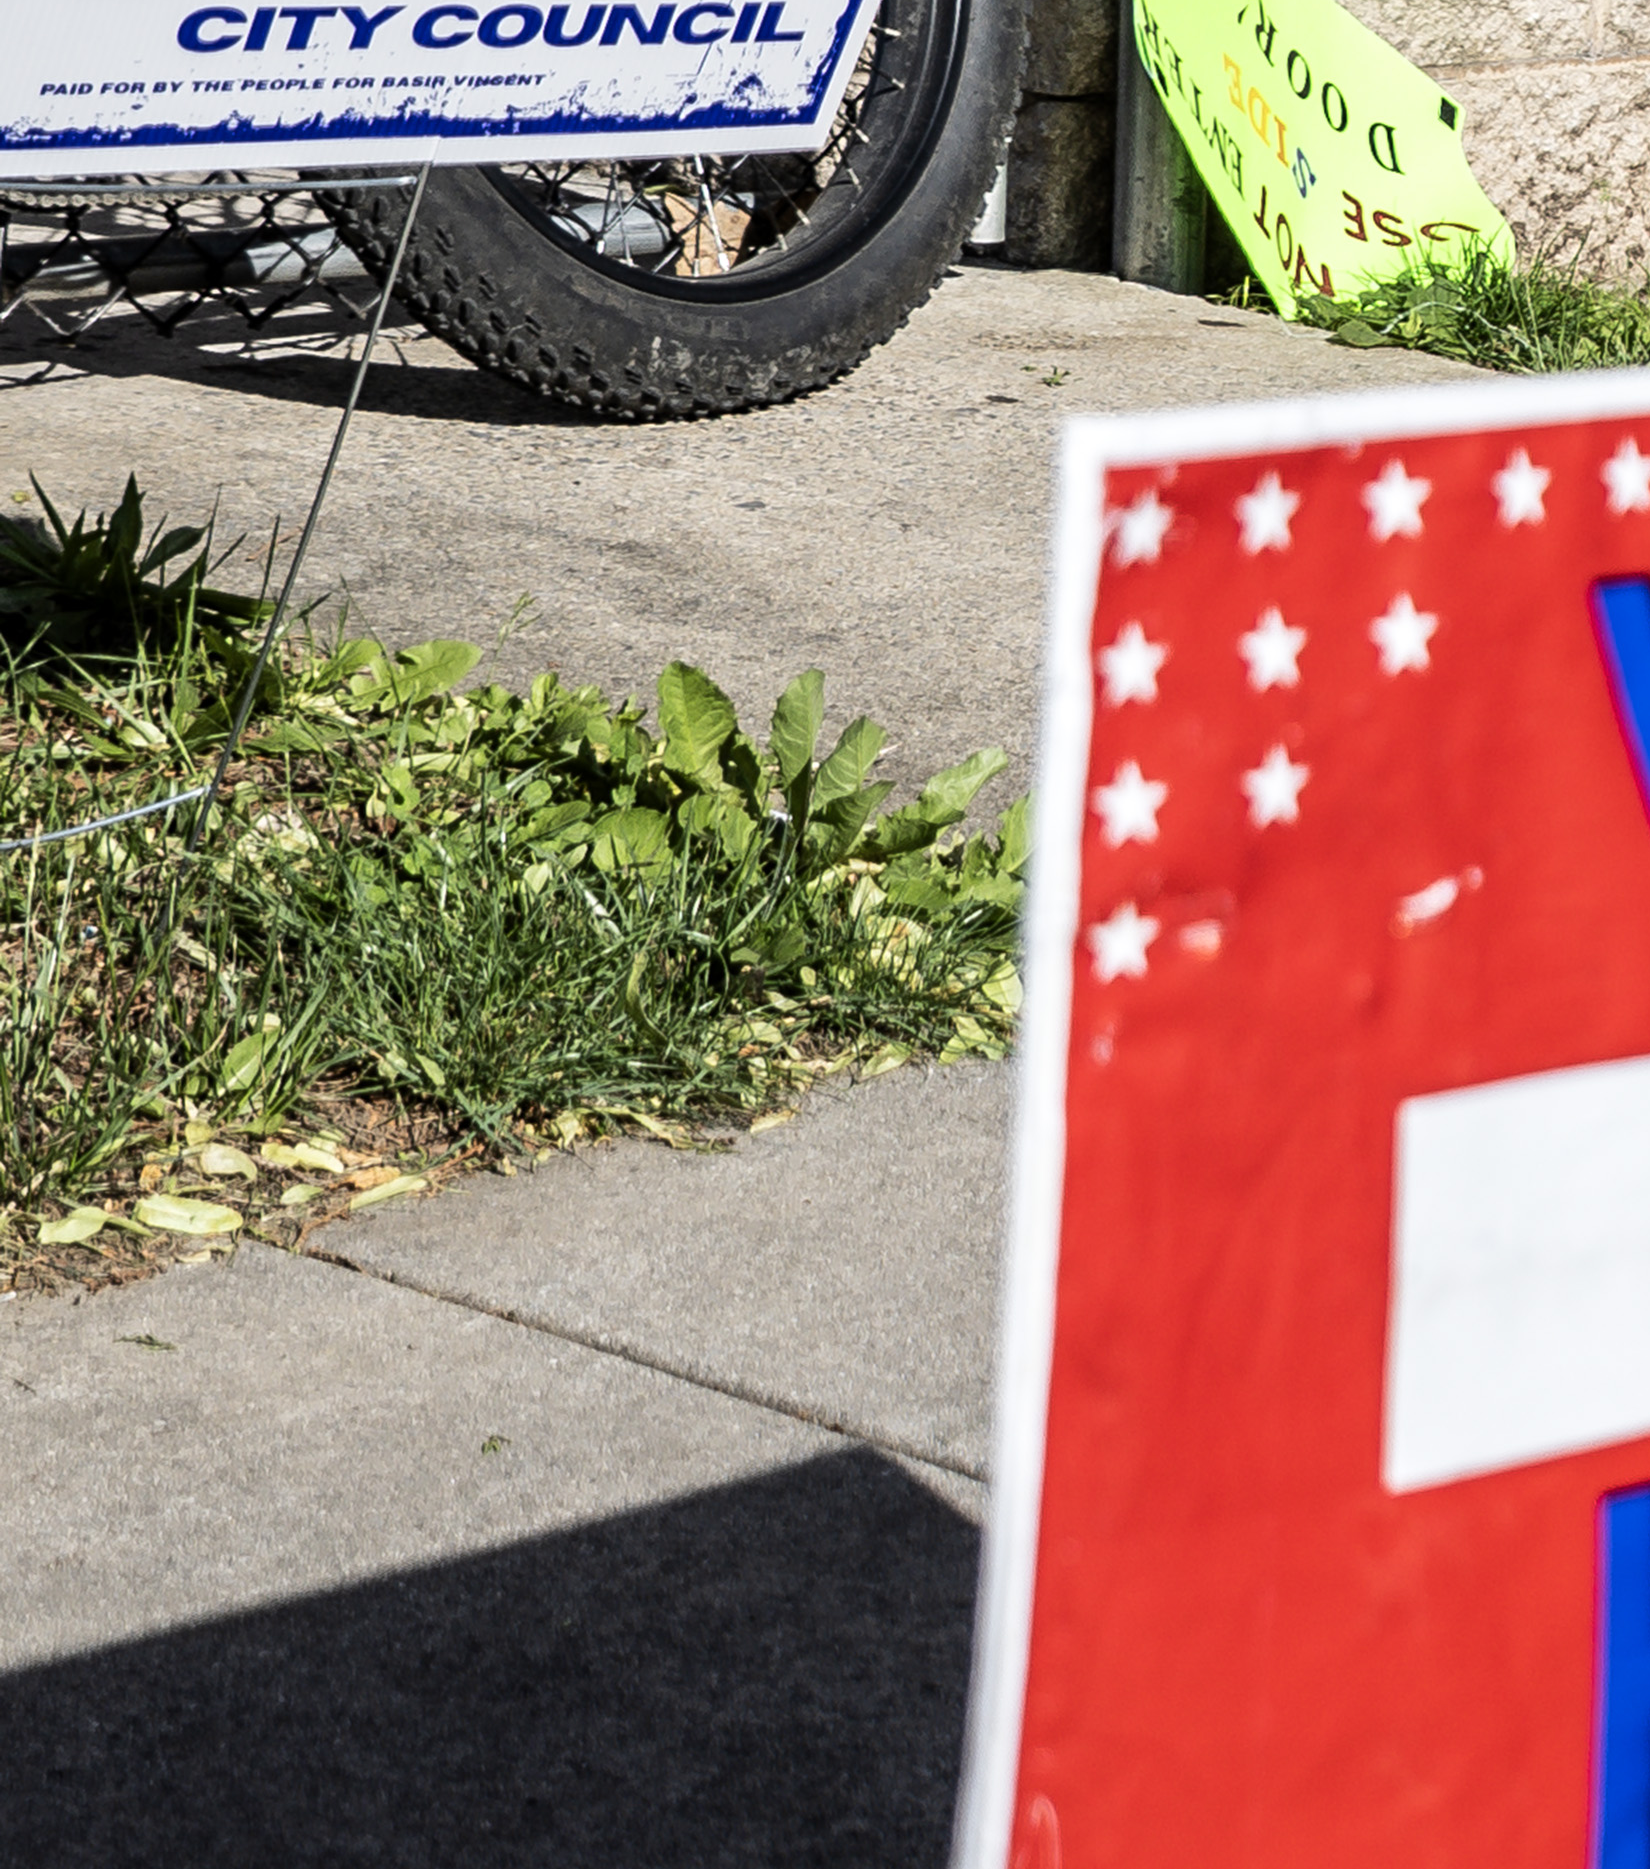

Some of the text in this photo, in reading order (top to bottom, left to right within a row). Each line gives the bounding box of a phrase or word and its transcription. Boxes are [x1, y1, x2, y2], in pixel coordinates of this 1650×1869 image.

[177, 2, 806, 53] CITY COUNCIL
[40, 74, 547, 95] PAID FOR BY THE PEOPLE FOR BASIR VINCENT
[1222, 52, 1317, 199] SIDE
